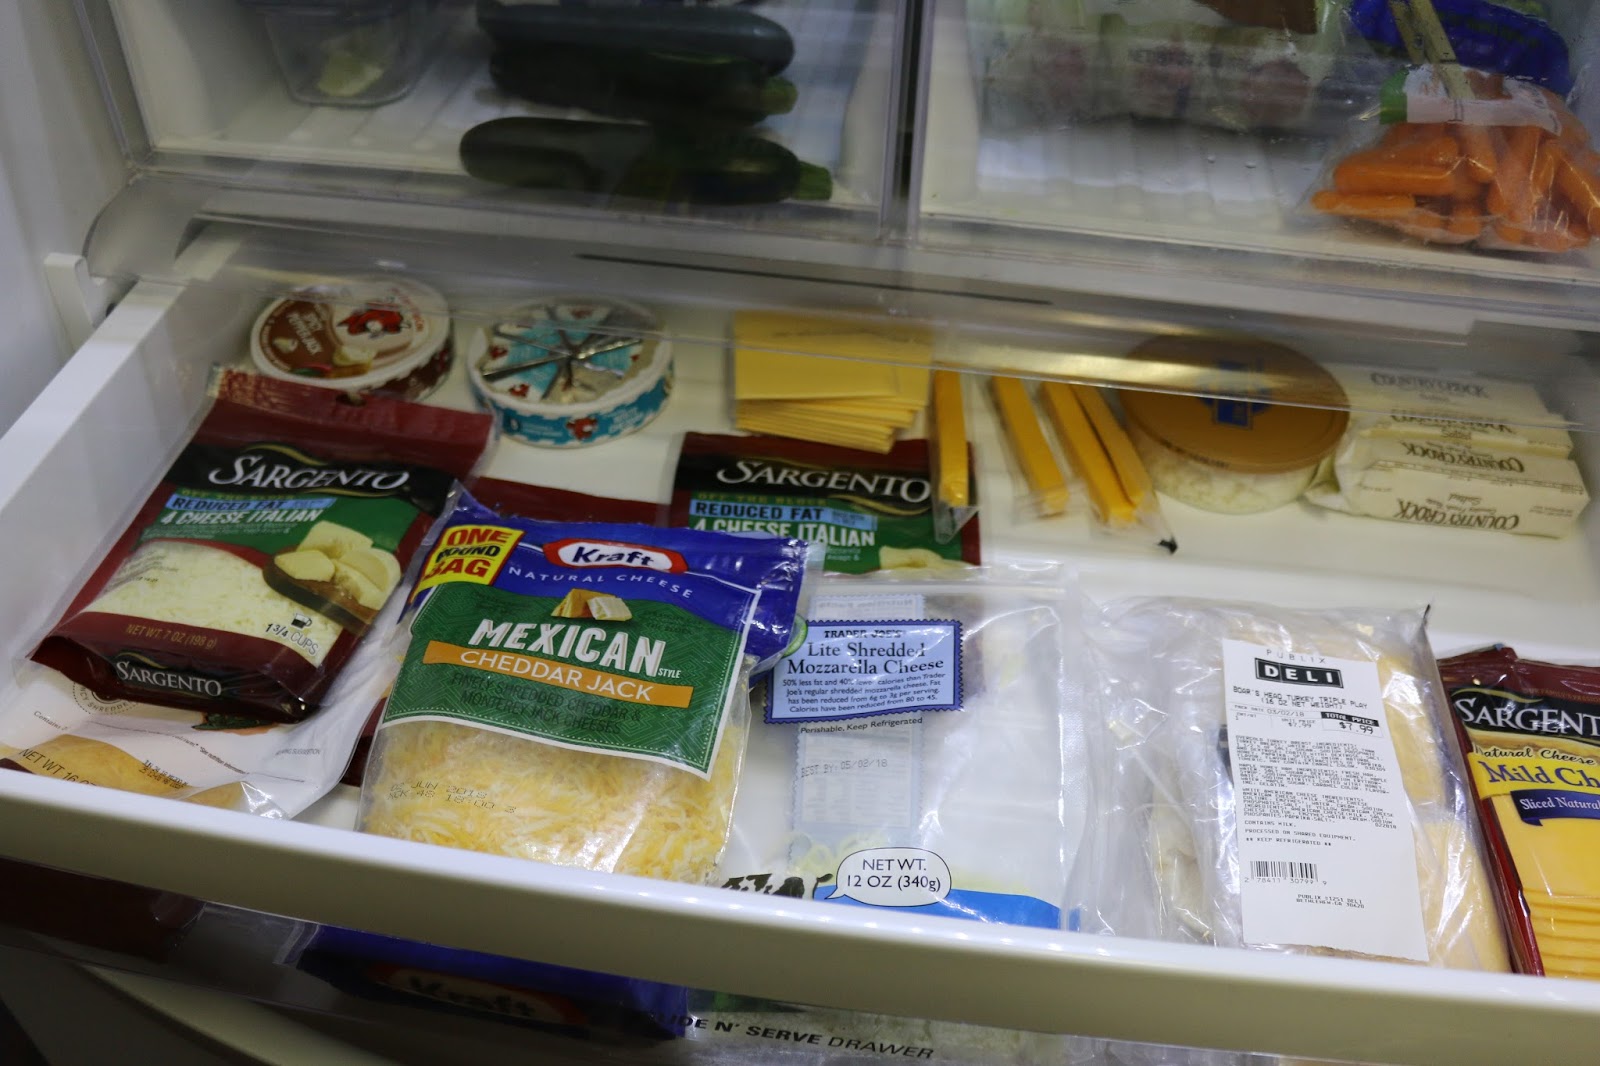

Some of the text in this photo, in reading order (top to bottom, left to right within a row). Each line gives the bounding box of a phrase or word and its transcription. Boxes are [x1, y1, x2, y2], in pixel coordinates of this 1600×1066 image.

[209, 455, 410, 490] SARGENTO
[1456, 454, 1525, 473] COUNTRY
[716, 460, 932, 503] SARGENTO
[172, 498, 250, 511] REDUCED
[254, 501, 287, 510] FAT
[695, 502, 782, 519] REDUCED
[790, 507, 825, 521] FAT
[161, 508, 324, 525] 4 CHEESE ITALIAN
[1393, 499, 1447, 525] CROCK
[1448, 512, 1520, 531] COUNTRY
[446, 528, 513, 546] ONE
[713, 519, 791, 538] CHEESE
[798, 523, 876, 547] ITALIAN
[573, 546, 655, 567] Kraft
[508, 566, 694, 599] NATURAL CHEESE
[126, 624, 144, 636] NET
[144, 627, 162, 638] WT.
[164, 630, 171, 639] 7
[171, 631, 185, 643] OZ
[185, 634, 205, 647] (198
[290, 631, 319, 657] CUPS
[824, 630, 902, 639] TRADER JOE'S
[468, 619, 667, 678] MEXICAN
[657, 667, 682, 679] STYLE
[808, 642, 926, 657] Lite Shredded
[1266, 649, 1326, 664] PUBLIX
[460, 651, 654, 702] CHEDDAR JACK
[787, 659, 945, 675] Mozzarella Cheese
[1264, 664, 1334, 683] DELI
[116, 661, 222, 697] SARGENTO
[783, 679, 797, 687] 50%
[877, 678, 905, 686] calories
[451, 671, 642, 721] FINELY SHREDDED CHEDDAR &
[786, 688, 803, 697] Joe's
[804, 688, 829, 697] regular
[830, 686, 863, 695] shredded
[864, 685, 902, 694] mozzarella
[903, 682, 929, 690] cheese.
[1233, 685, 1367, 709] BOAR'S HEAD TURKEY TRIPLE PLAY
[87, 701, 128, 713] SHREDDE
[787, 697, 799, 705] has
[850, 695, 868, 703] from
[869, 695, 878, 703] 6g
[789, 705, 819, 713] Calories
[857, 701, 886, 710] reduced
[887, 698, 905, 706] from
[1292, 700, 1305, 708] NET
[459, 690, 622, 734] MONTEREY JACK CHEESES
[1325, 712, 1375, 725] TOTAL PRICE
[846, 723, 868, 732] Keep
[870, 717, 923, 728] Refrigerated
[1339, 721, 1374, 734] $7.99
[19, 749, 46, 764] NET
[42, 759, 65, 775] WT
[1475, 745, 1596, 766] Natural Cheese
[801, 764, 820, 778] BEST
[1478, 761, 1554, 784] Mild
[411, 780, 438, 790] JUN
[1520, 796, 1600, 810] Sliced Natural
[1276, 838, 1321, 846] REFRIGERATED
[862, 858, 927, 871] NET WT.
[847, 874, 942, 893] 12 OZ (340g)
[649, 1013, 709, 1030] LIDE
[746, 1026, 823, 1045] SERVE
[827, 1036, 934, 1060] DRAWER
